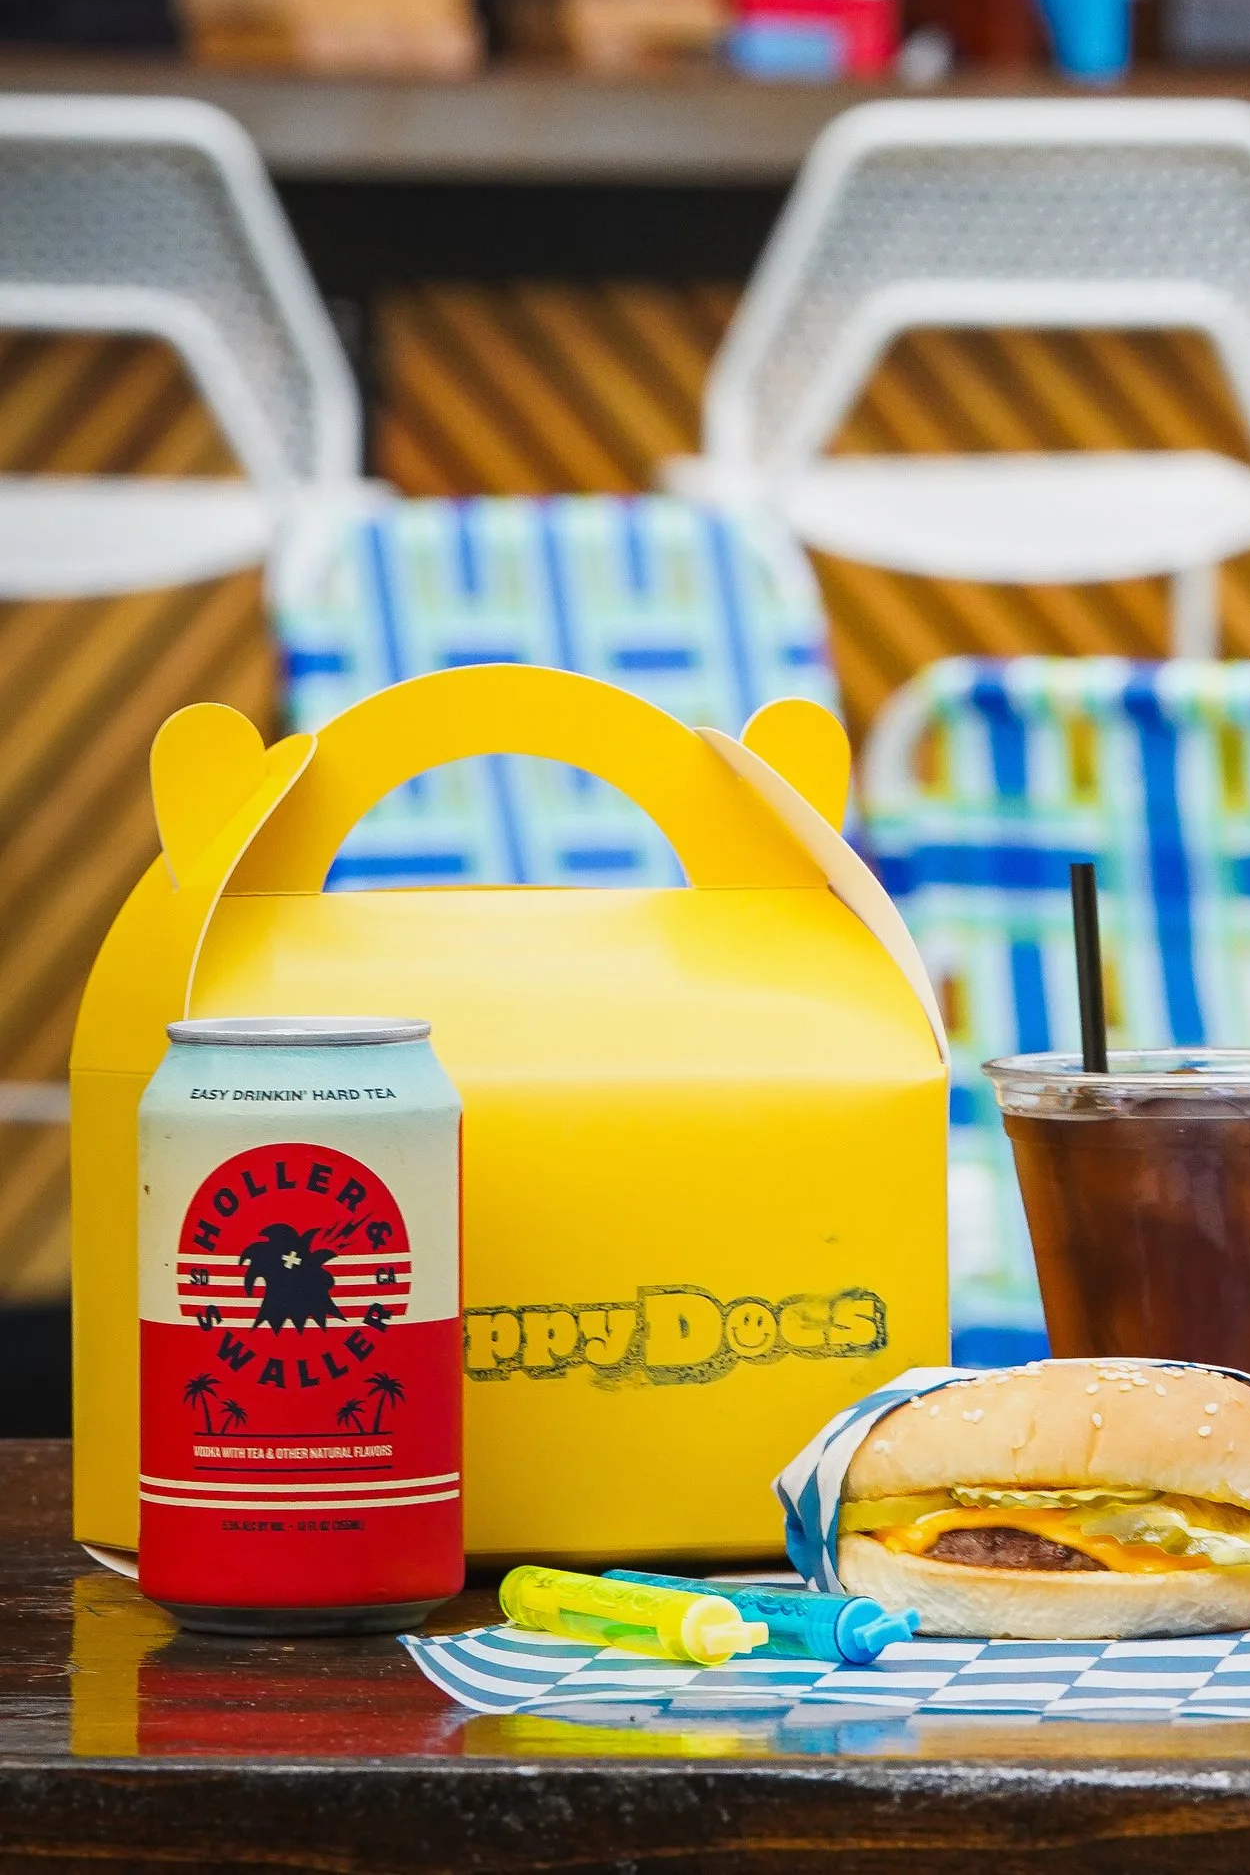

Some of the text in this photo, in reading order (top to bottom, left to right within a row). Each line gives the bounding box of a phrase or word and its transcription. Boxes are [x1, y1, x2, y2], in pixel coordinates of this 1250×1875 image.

[190, 1088, 228, 1100] EASY
[312, 1089, 360, 1100] HARD
[364, 1087, 397, 1099] TEA
[192, 1161, 393, 1252] HOLLER &
[376, 1267, 397, 1285] CA
[196, 1302, 394, 1389] SWALLER
[193, 1445, 393, 1459] VODKA WITH TEA & OTHER NATURAL FLAVORS
